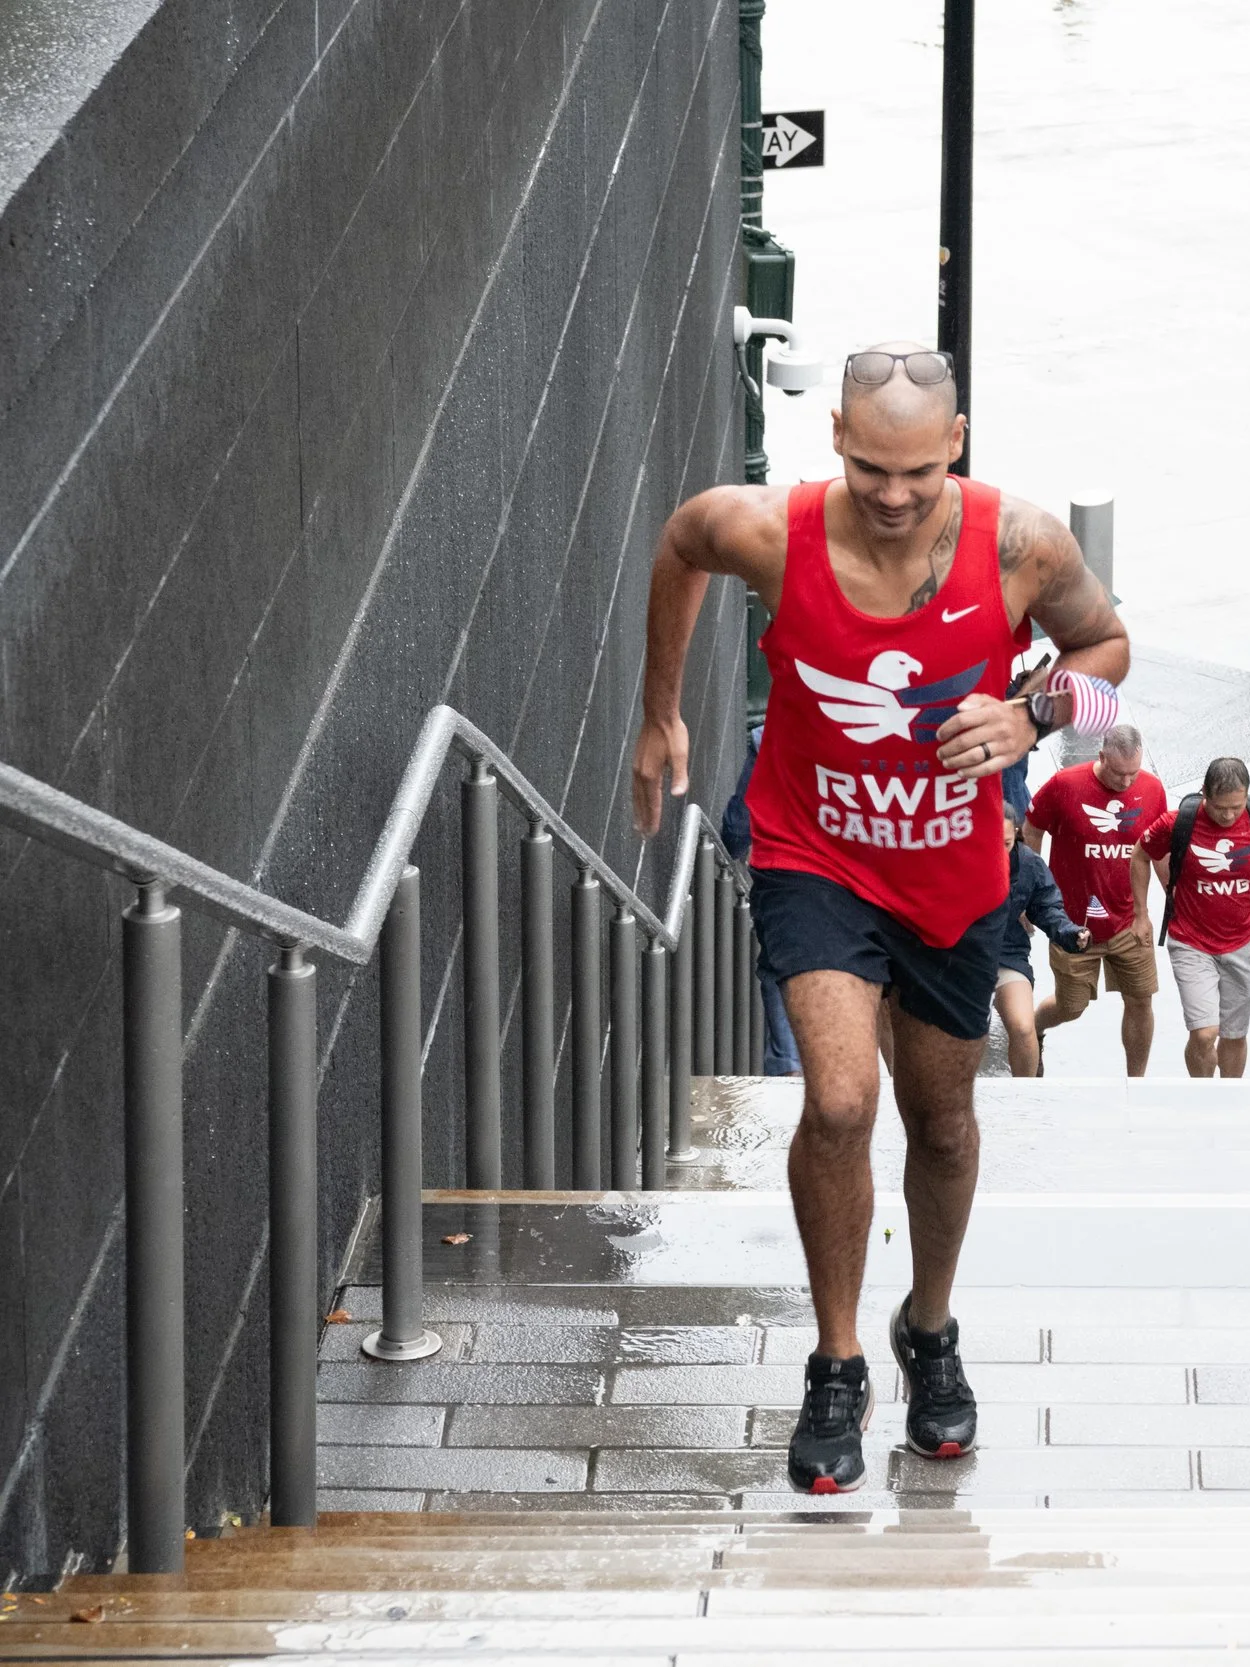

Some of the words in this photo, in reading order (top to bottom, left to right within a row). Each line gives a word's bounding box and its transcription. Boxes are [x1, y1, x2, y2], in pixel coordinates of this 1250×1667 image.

[762, 130, 798, 153] AY
[860, 759, 929, 773] TEAM
[815, 763, 979, 816] RWB
[817, 803, 974, 850] CARLOS
[1196, 878, 1250, 896] RWB
